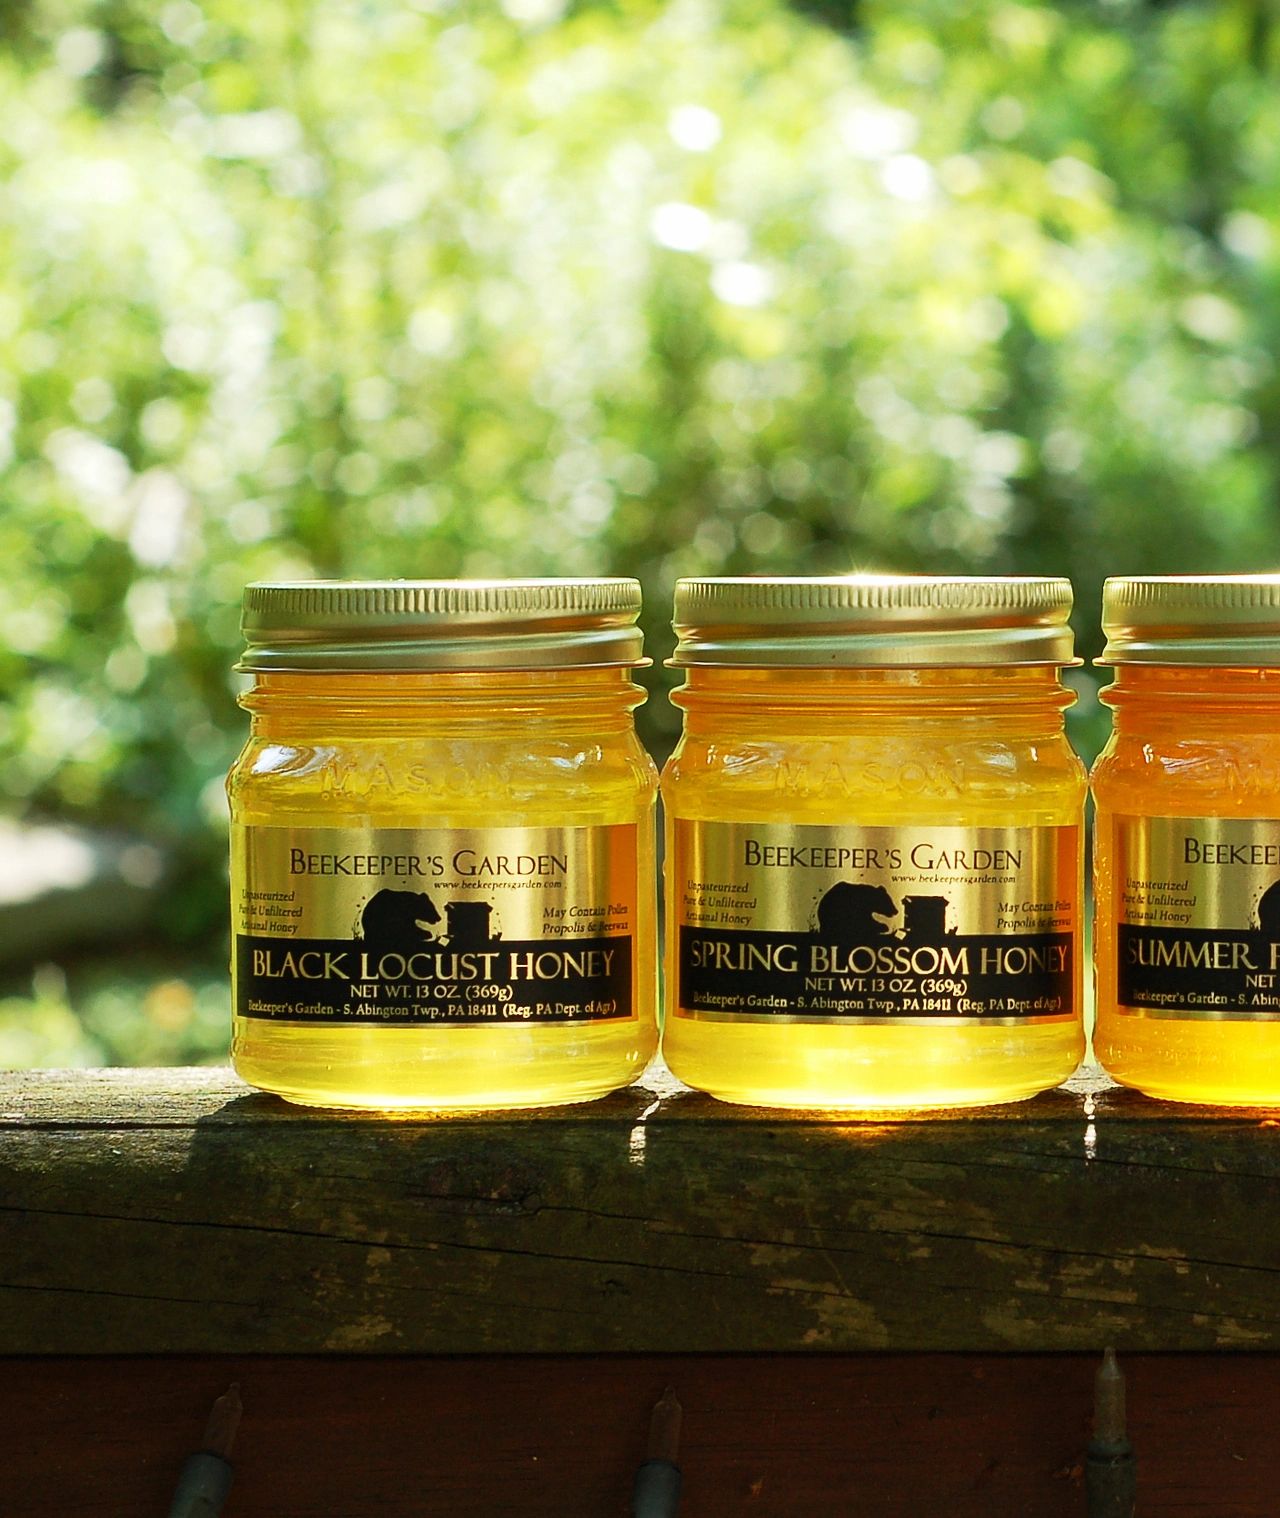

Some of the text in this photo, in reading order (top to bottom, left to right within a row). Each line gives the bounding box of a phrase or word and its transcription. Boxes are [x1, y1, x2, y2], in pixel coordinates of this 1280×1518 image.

[708, 897, 757, 909] Unfiltered
[1147, 893, 1196, 907] Unfiltered
[259, 905, 302, 917] Unfiltered
[543, 907, 566, 920] May
[998, 902, 1019, 914] May
[721, 912, 752, 926] Honey
[1160, 909, 1192, 923] Honey
[269, 921, 298, 933] Honey
[543, 921, 585, 936] Propolis
[997, 918, 1035, 931] Propolis
[690, 940, 1068, 975] SPRING BLOSSOM HONEY
[1127, 938, 1258, 970] SUMMER
[253, 949, 614, 980] BLACK LOCUST HONEY
[805, 978, 835, 991] NET
[840, 978, 867, 992] WT.
[872, 979, 884, 992] 13
[921, 979, 967, 996] (369g)
[1246, 975, 1276, 988] NET
[350, 985, 378, 998] NET
[385, 985, 411, 998] WT.
[416, 985, 429, 998] 13
[466, 985, 514, 1001] (369g)
[1187, 992, 1228, 1005] Garden
[1238, 994, 1248, 1005] S.
[295, 1002, 333, 1015] Garden
[344, 1004, 353, 1015] S.
[356, 1003, 408, 1018] Abington
[448, 1005, 465, 1016] PA
[468, 1005, 496, 1016] 18411
[536, 1004, 552, 1015] PA
[747, 995, 787, 1007] Garden
[797, 996, 807, 1008] S.
[811, 997, 864, 1012] Abington
[903, 999, 919, 1010] PA
[923, 999, 951, 1010] 18411
[989, 999, 1005, 1010] PA
